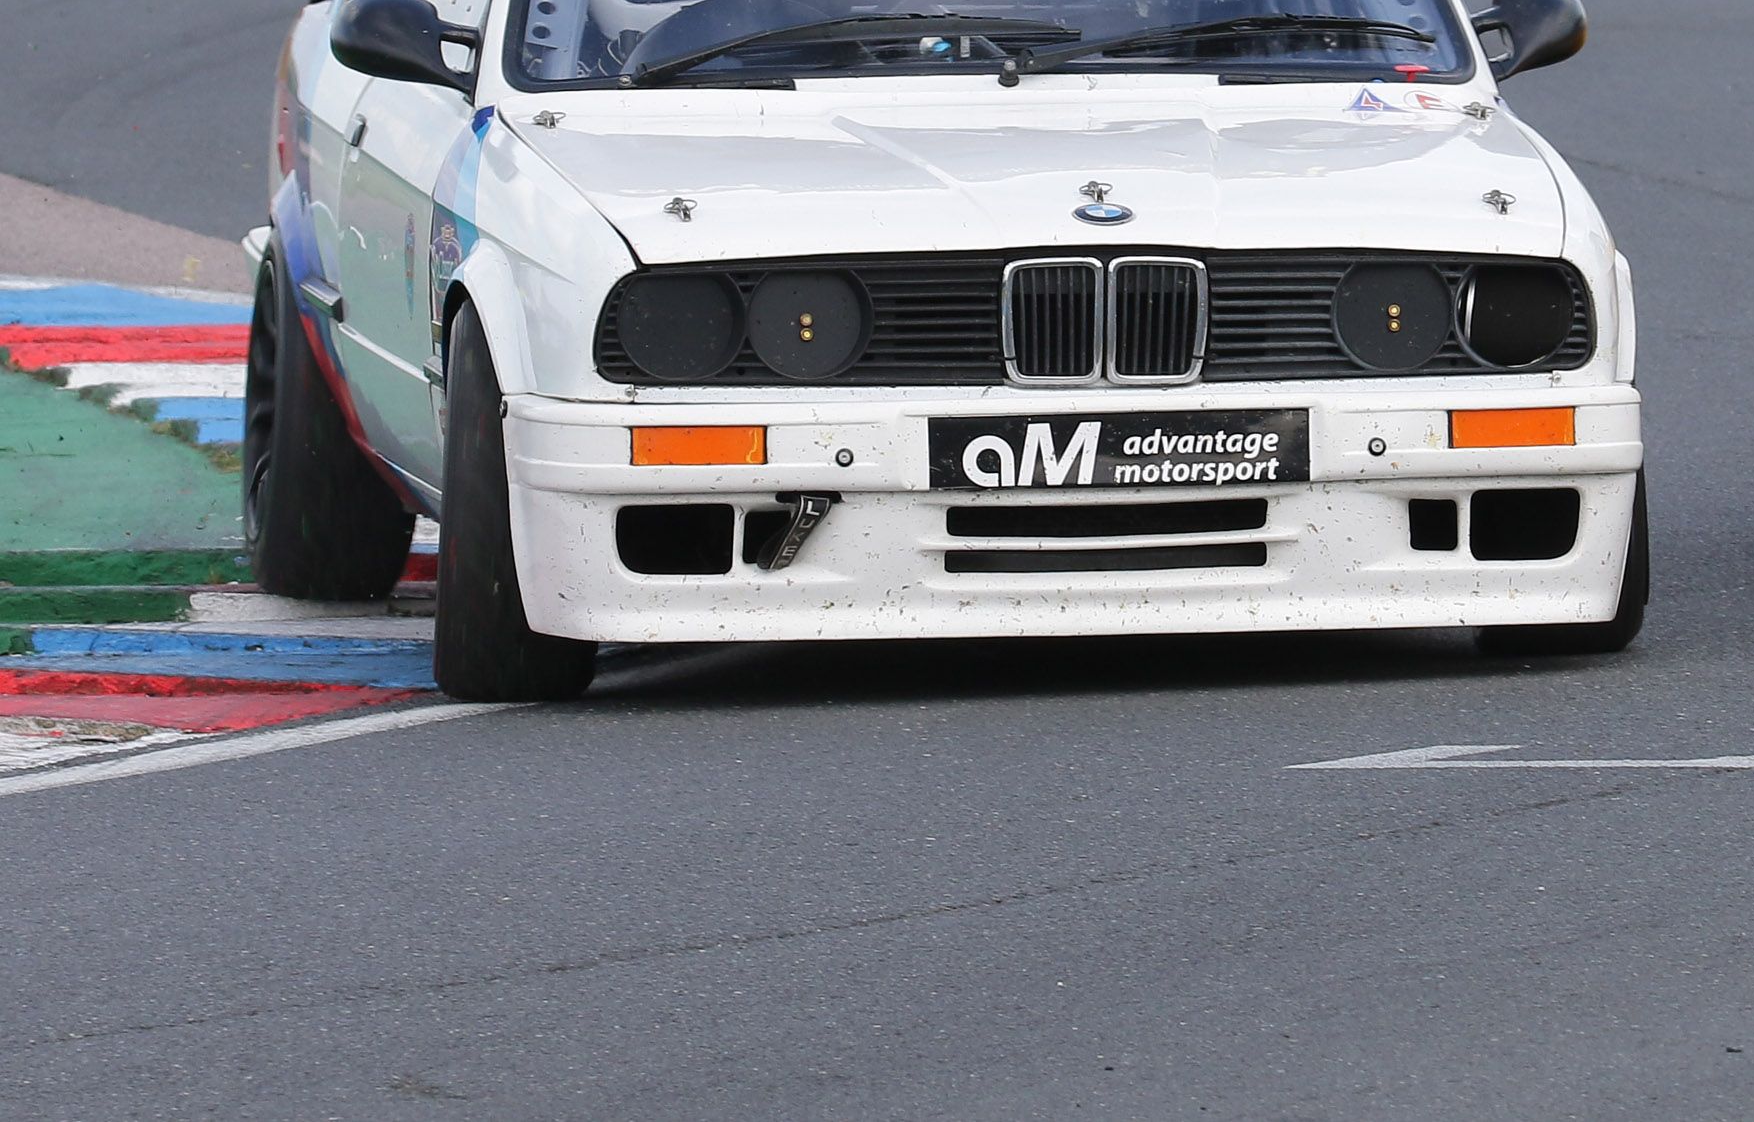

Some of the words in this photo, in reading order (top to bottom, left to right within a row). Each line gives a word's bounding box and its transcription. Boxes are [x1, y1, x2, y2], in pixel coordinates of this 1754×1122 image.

[962, 421, 1102, 487] aM
[1123, 429, 1279, 459] advantage
[1115, 457, 1279, 485] motorsport
